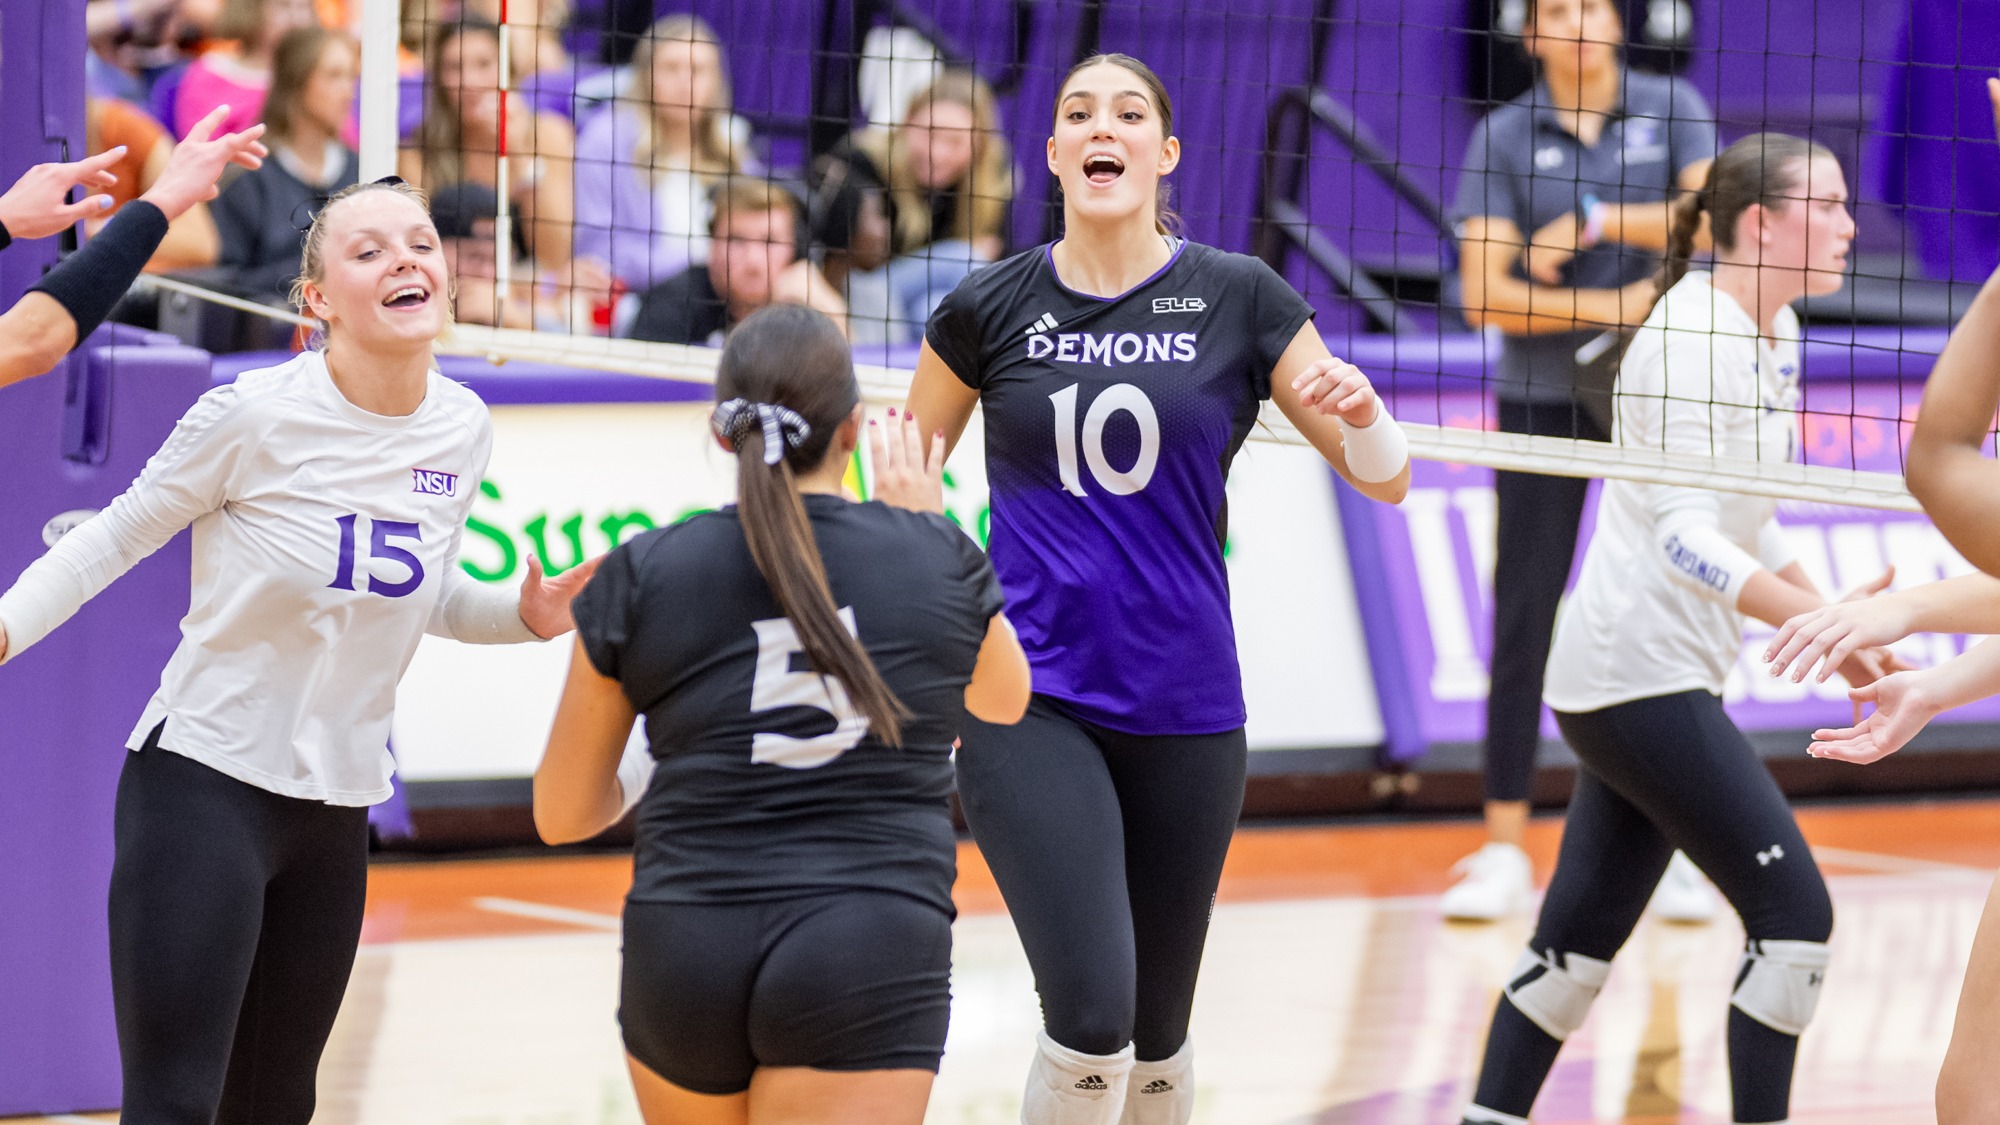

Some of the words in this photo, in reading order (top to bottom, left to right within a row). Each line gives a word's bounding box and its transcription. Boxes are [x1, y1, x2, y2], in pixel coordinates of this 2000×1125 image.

[1153, 298, 1206, 313] SLC
[1028, 332, 1197, 367] DEMONS
[1048, 383, 1160, 497] 10
[414, 469, 458, 497] NSU
[327, 513, 425, 598] 15
[750, 605, 870, 770] 5
[1074, 1082, 1108, 1090] adidas
[1141, 1084, 1173, 1094] adidas
